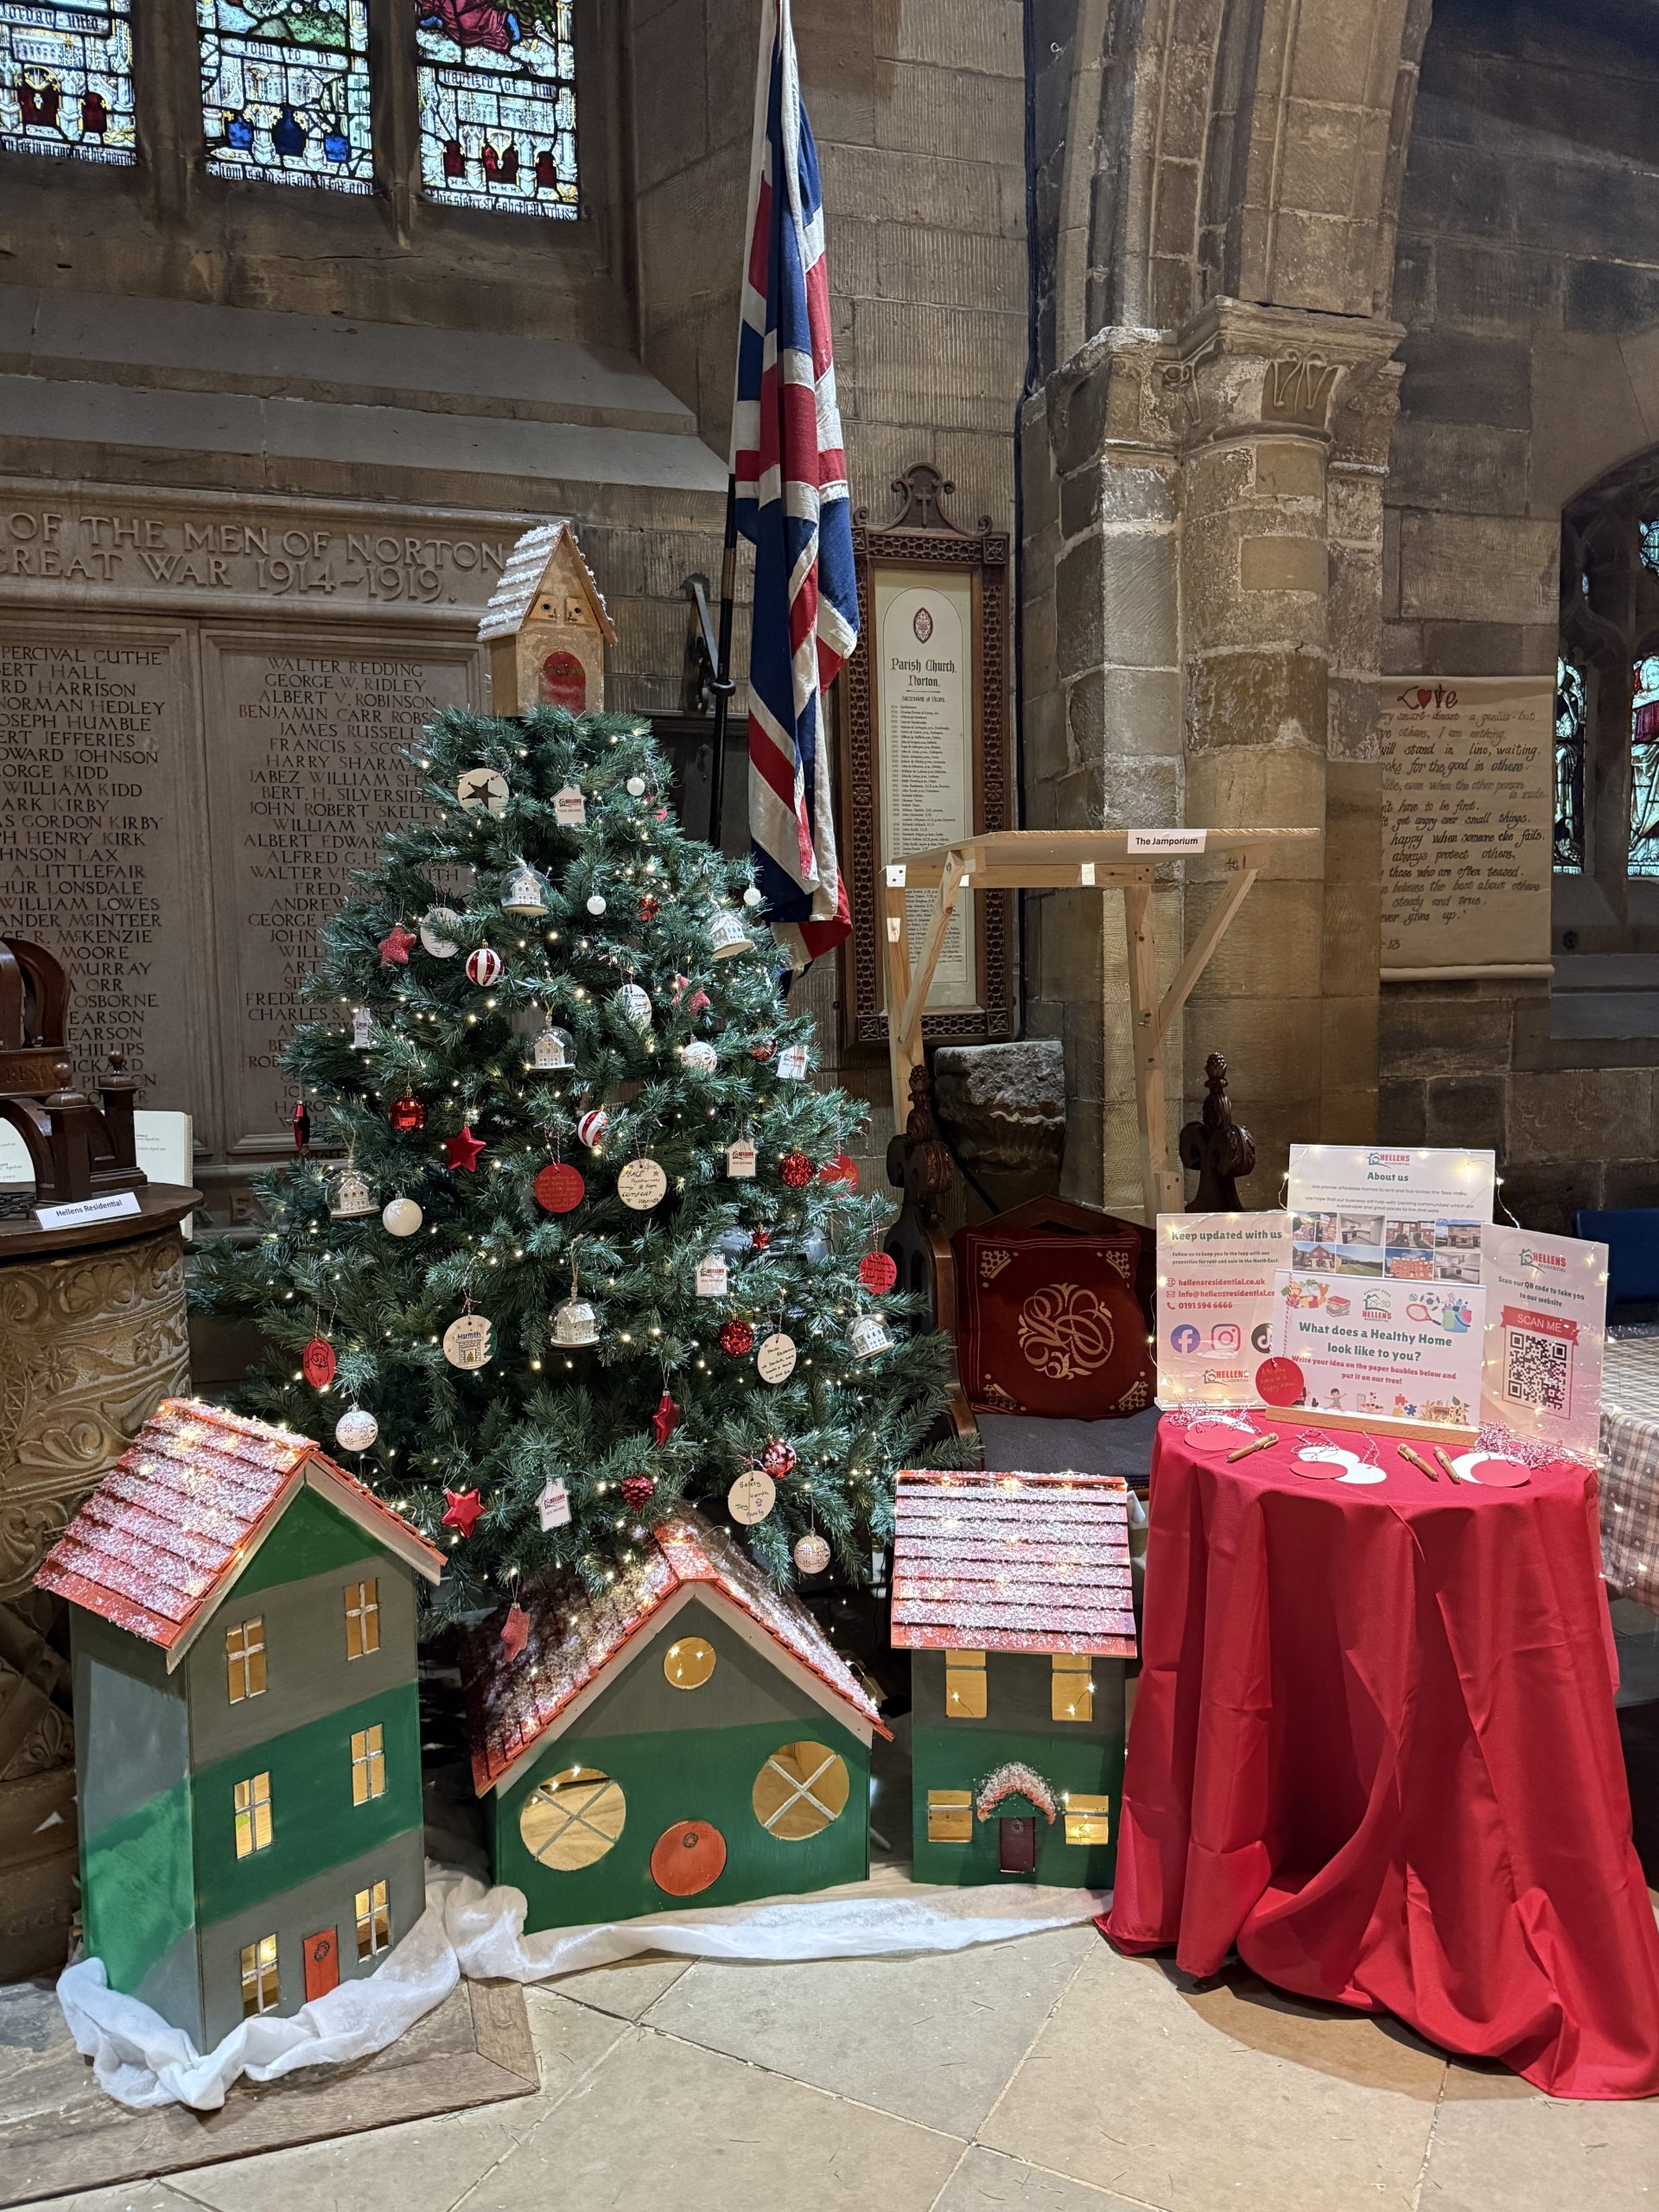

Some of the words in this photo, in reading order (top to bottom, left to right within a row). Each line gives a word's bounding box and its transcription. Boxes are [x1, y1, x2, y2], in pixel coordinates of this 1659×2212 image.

[8, 512, 63, 543] OF
[79, 516, 168, 550] THE
[184, 523, 270, 557] MEN
[282, 530, 333, 561] OF
[346, 532, 507, 574] NORTON
[138, 552, 233, 588] WAR
[94, 650, 162, 665] GUTHE
[52, 664, 106, 680] HALL
[268, 658, 343, 674] WALTER
[349, 661, 423, 677] REDDING
[892, 658, 921, 673] Parish
[39, 681, 136, 696] HARRISON
[264, 674, 334, 690] GEORGE
[364, 678, 427, 693] RIDLEY
[259, 690, 327, 705] ALBERT
[356, 693, 437, 709] ROBINSON
[91, 700, 166, 716] HEDLEY
[239, 704, 327, 721] BENJAMIN
[337, 709, 383, 723] CARR
[68, 715, 152, 732] HUMBLE
[281, 722, 338, 738] JAMES
[45, 732, 136, 747] JEFFERIES
[270, 738, 346, 753] FRANCIS
[75, 749, 158, 764] JOHNSON
[1404, 743, 1435, 755] stand
[1445, 744, 1453, 755] in
[267, 754, 330, 768] HARRY
[1407, 758, 1427, 775] for
[1443, 760, 1469, 778] good
[1475, 760, 1484, 771] in
[64, 766, 109, 780] KIDD
[250, 769, 301, 784] JABEZ
[309, 772, 390, 786] WILLIAM
[5, 781, 91, 796] WILLIAM
[98, 784, 143, 797] KIDD
[53, 798, 110, 813] KIRBY
[251, 802, 296, 816] JOHN
[305, 804, 370, 817] ROBERT
[1399, 799, 1419, 812] have
[1425, 800, 1433, 811] to
[1440, 800, 1450, 810] be
[22, 815, 102, 830] GORDON
[110, 817, 163, 830] KIRBY
[273, 818, 356, 833] WILLIAM
[1392, 817, 1410, 832] get
[1415, 816, 1438, 830] angry
[1465, 812, 1491, 824] small
[27, 831, 92, 845] HENRY
[103, 833, 146, 847] KIRK
[244, 835, 313, 848] ALBERT
[1152, 837, 1198, 846] Jamporium
[1390, 833, 1423, 849] happy
[1433, 830, 1457, 843] when
[1462, 834, 1494, 842] someone
[79, 849, 119, 861] LAX
[267, 850, 338, 864] ALFRED
[1392, 849, 1427, 866] always
[1434, 850, 1469, 864] protect
[35, 864, 146, 879] LITTLEFAIR
[250, 866, 321, 880] WALTER
[1389, 866, 1412, 878] those
[1417, 866, 1435, 878] who
[1457, 866, 1480, 878] often
[48, 881, 143, 895] LONSDALE
[296, 882, 341, 896] FRED
[97, 898, 160, 912] LOWES
[1432, 895, 1452, 906] and
[248, 913, 316, 927] GEORGE
[270, 929, 317, 943] JOHN
[60, 946, 130, 960] MOORE
[69, 962, 152, 976] MURRAY
[86, 978, 124, 992] ORR
[248, 1007, 327, 1021] CHARLES
[1367, 1173, 1395, 1181] About
[1398, 1173, 1409, 1182] us
[55, 1206, 83, 1217] Hellens
[84, 1199, 123, 1212] Residential
[1172, 1230, 1198, 1242] Keep
[1199, 1230, 1243, 1242] updated
[1245, 1230, 1268, 1239] with
[1270, 1230, 1282, 1239] us
[1533, 1251, 1567, 1268] HELLENS
[1558, 1288, 1572, 1297] take
[1538, 1297, 1562, 1307] website
[1362, 1310, 1392, 1319] HELLENS
[1517, 1313, 1544, 1331] SCAN
[1547, 1320, 1562, 1332] ME
[1299, 1321, 1330, 1334] What
[1332, 1325, 1358, 1338] does
[1370, 1329, 1416, 1344] Healthy
[1419, 1333, 1452, 1346] Home
[1327, 1342, 1351, 1355] look
[1355, 1345, 1375, 1357] like
[1377, 1349, 1389, 1358] to
[1392, 1351, 1421, 1362] you?
[1292, 1355, 1313, 1363] Write
[1313, 1358, 1328, 1367] your
[1329, 1359, 1344, 1368] idea
[1369, 1363, 1389, 1372] paper
[1390, 1365, 1418, 1376] baubles
[1419, 1369, 1441, 1377] below
[1385, 1376, 1402, 1385] tree!
